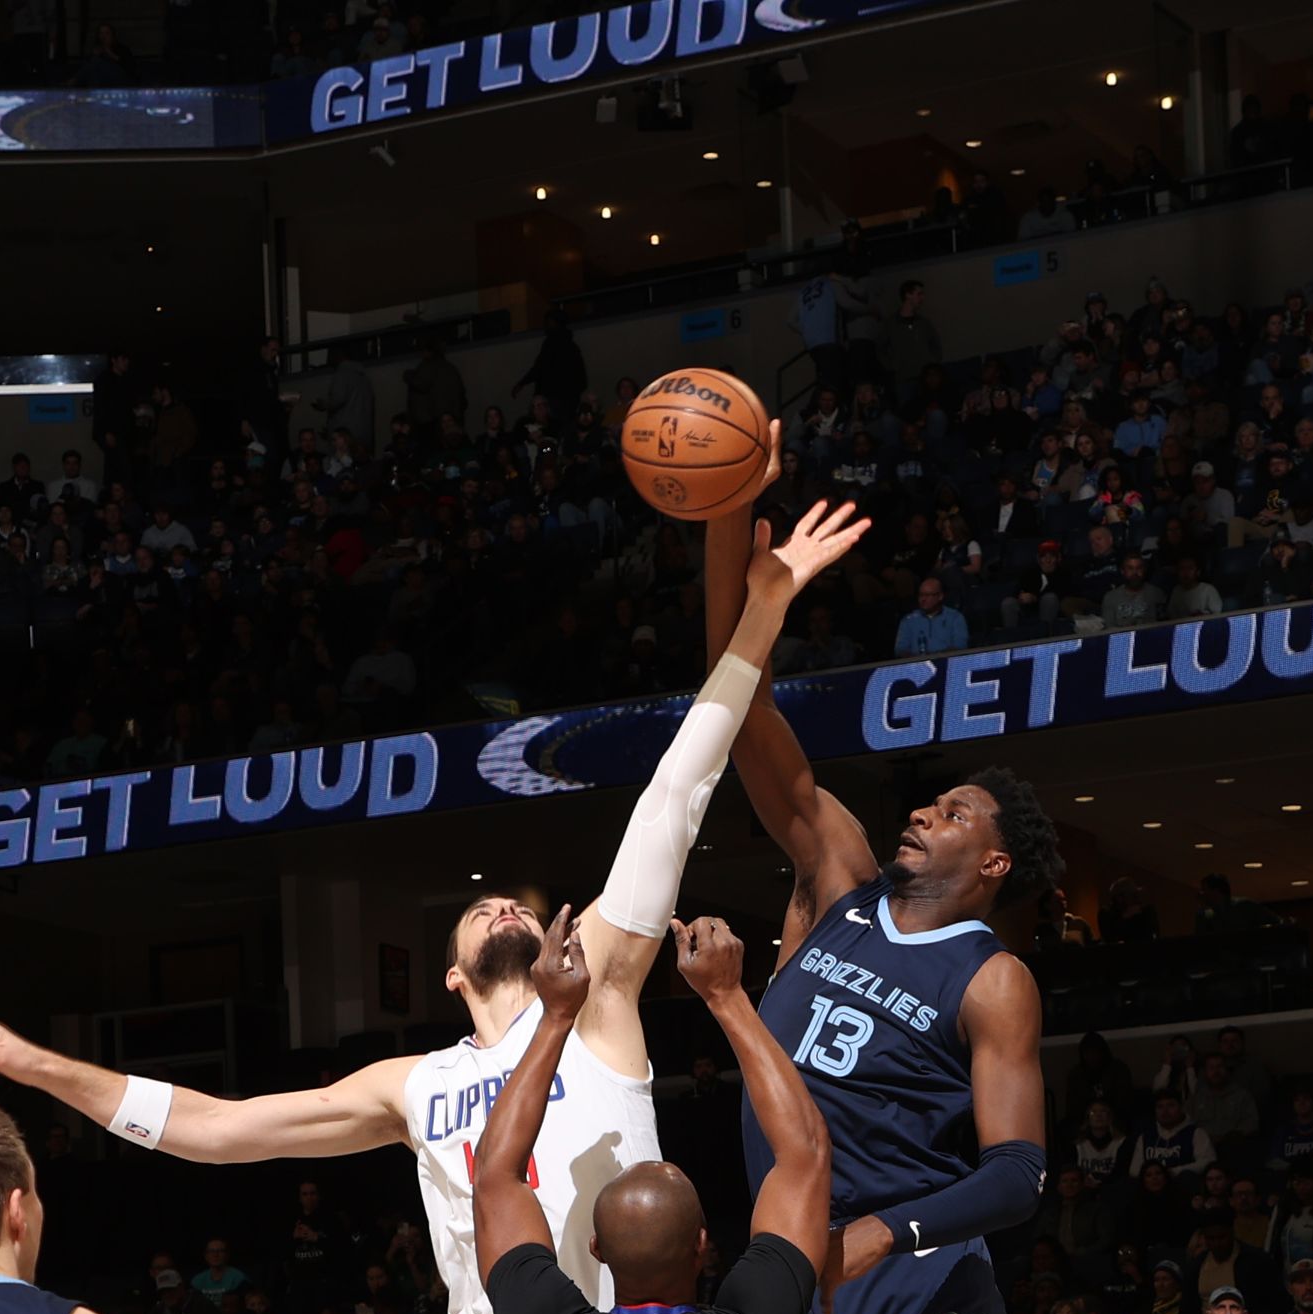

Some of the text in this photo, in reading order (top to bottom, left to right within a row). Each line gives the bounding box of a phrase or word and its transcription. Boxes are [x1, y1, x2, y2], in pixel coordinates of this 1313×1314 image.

[310, 0, 747, 134] GET LOUD
[862, 637, 1083, 752] GET
[170, 731, 438, 824] LOUD
[793, 993, 875, 1078] 13
[800, 947, 939, 1032] GRIZZLIES
